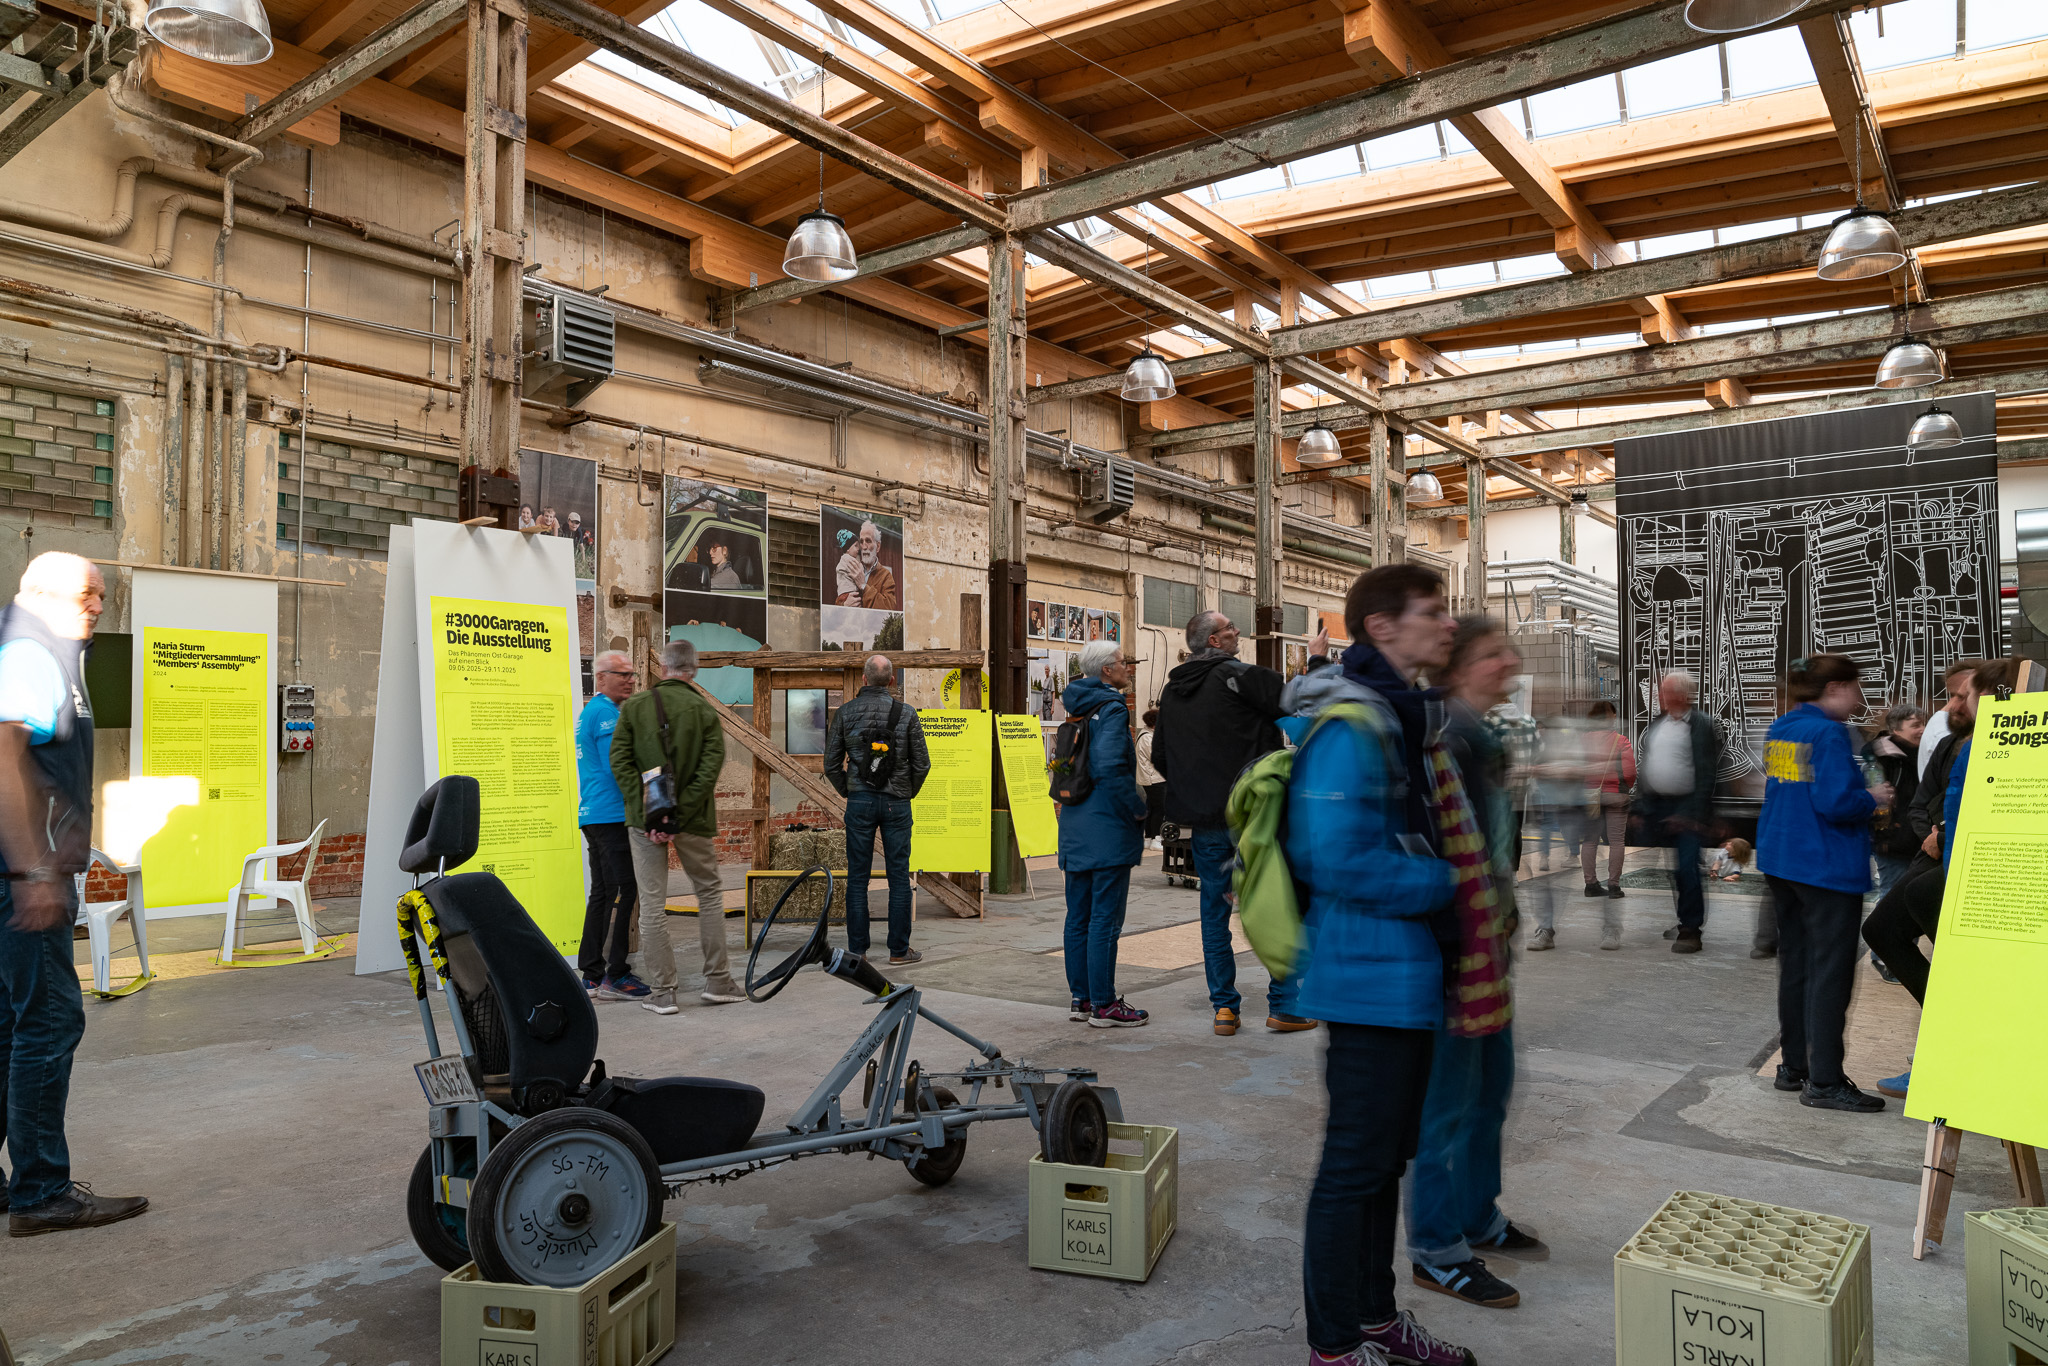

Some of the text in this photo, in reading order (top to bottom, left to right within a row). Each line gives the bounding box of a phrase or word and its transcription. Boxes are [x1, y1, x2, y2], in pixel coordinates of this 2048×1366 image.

[446, 612, 549, 634] #3000Garagen.
[153, 642, 205, 652] Maria Sturm
[446, 629, 551, 652] Die Ausstellung
[1992, 711, 2038, 730] Tanja
[1985, 751, 2010, 759] 2025
[858, 1042, 876, 1062] Muscle
[424, 1068, 440, 1099] C
[1067, 1218, 1106, 1234] KARLS
[520, 1213, 598, 1263] Muscle Car
[1067, 1240, 1105, 1256] KOLA
[1683, 1306, 1753, 1341] KOLA
[2008, 1300, 2048, 1338] ARLS
[486, 1352, 531, 1366] KARLS
